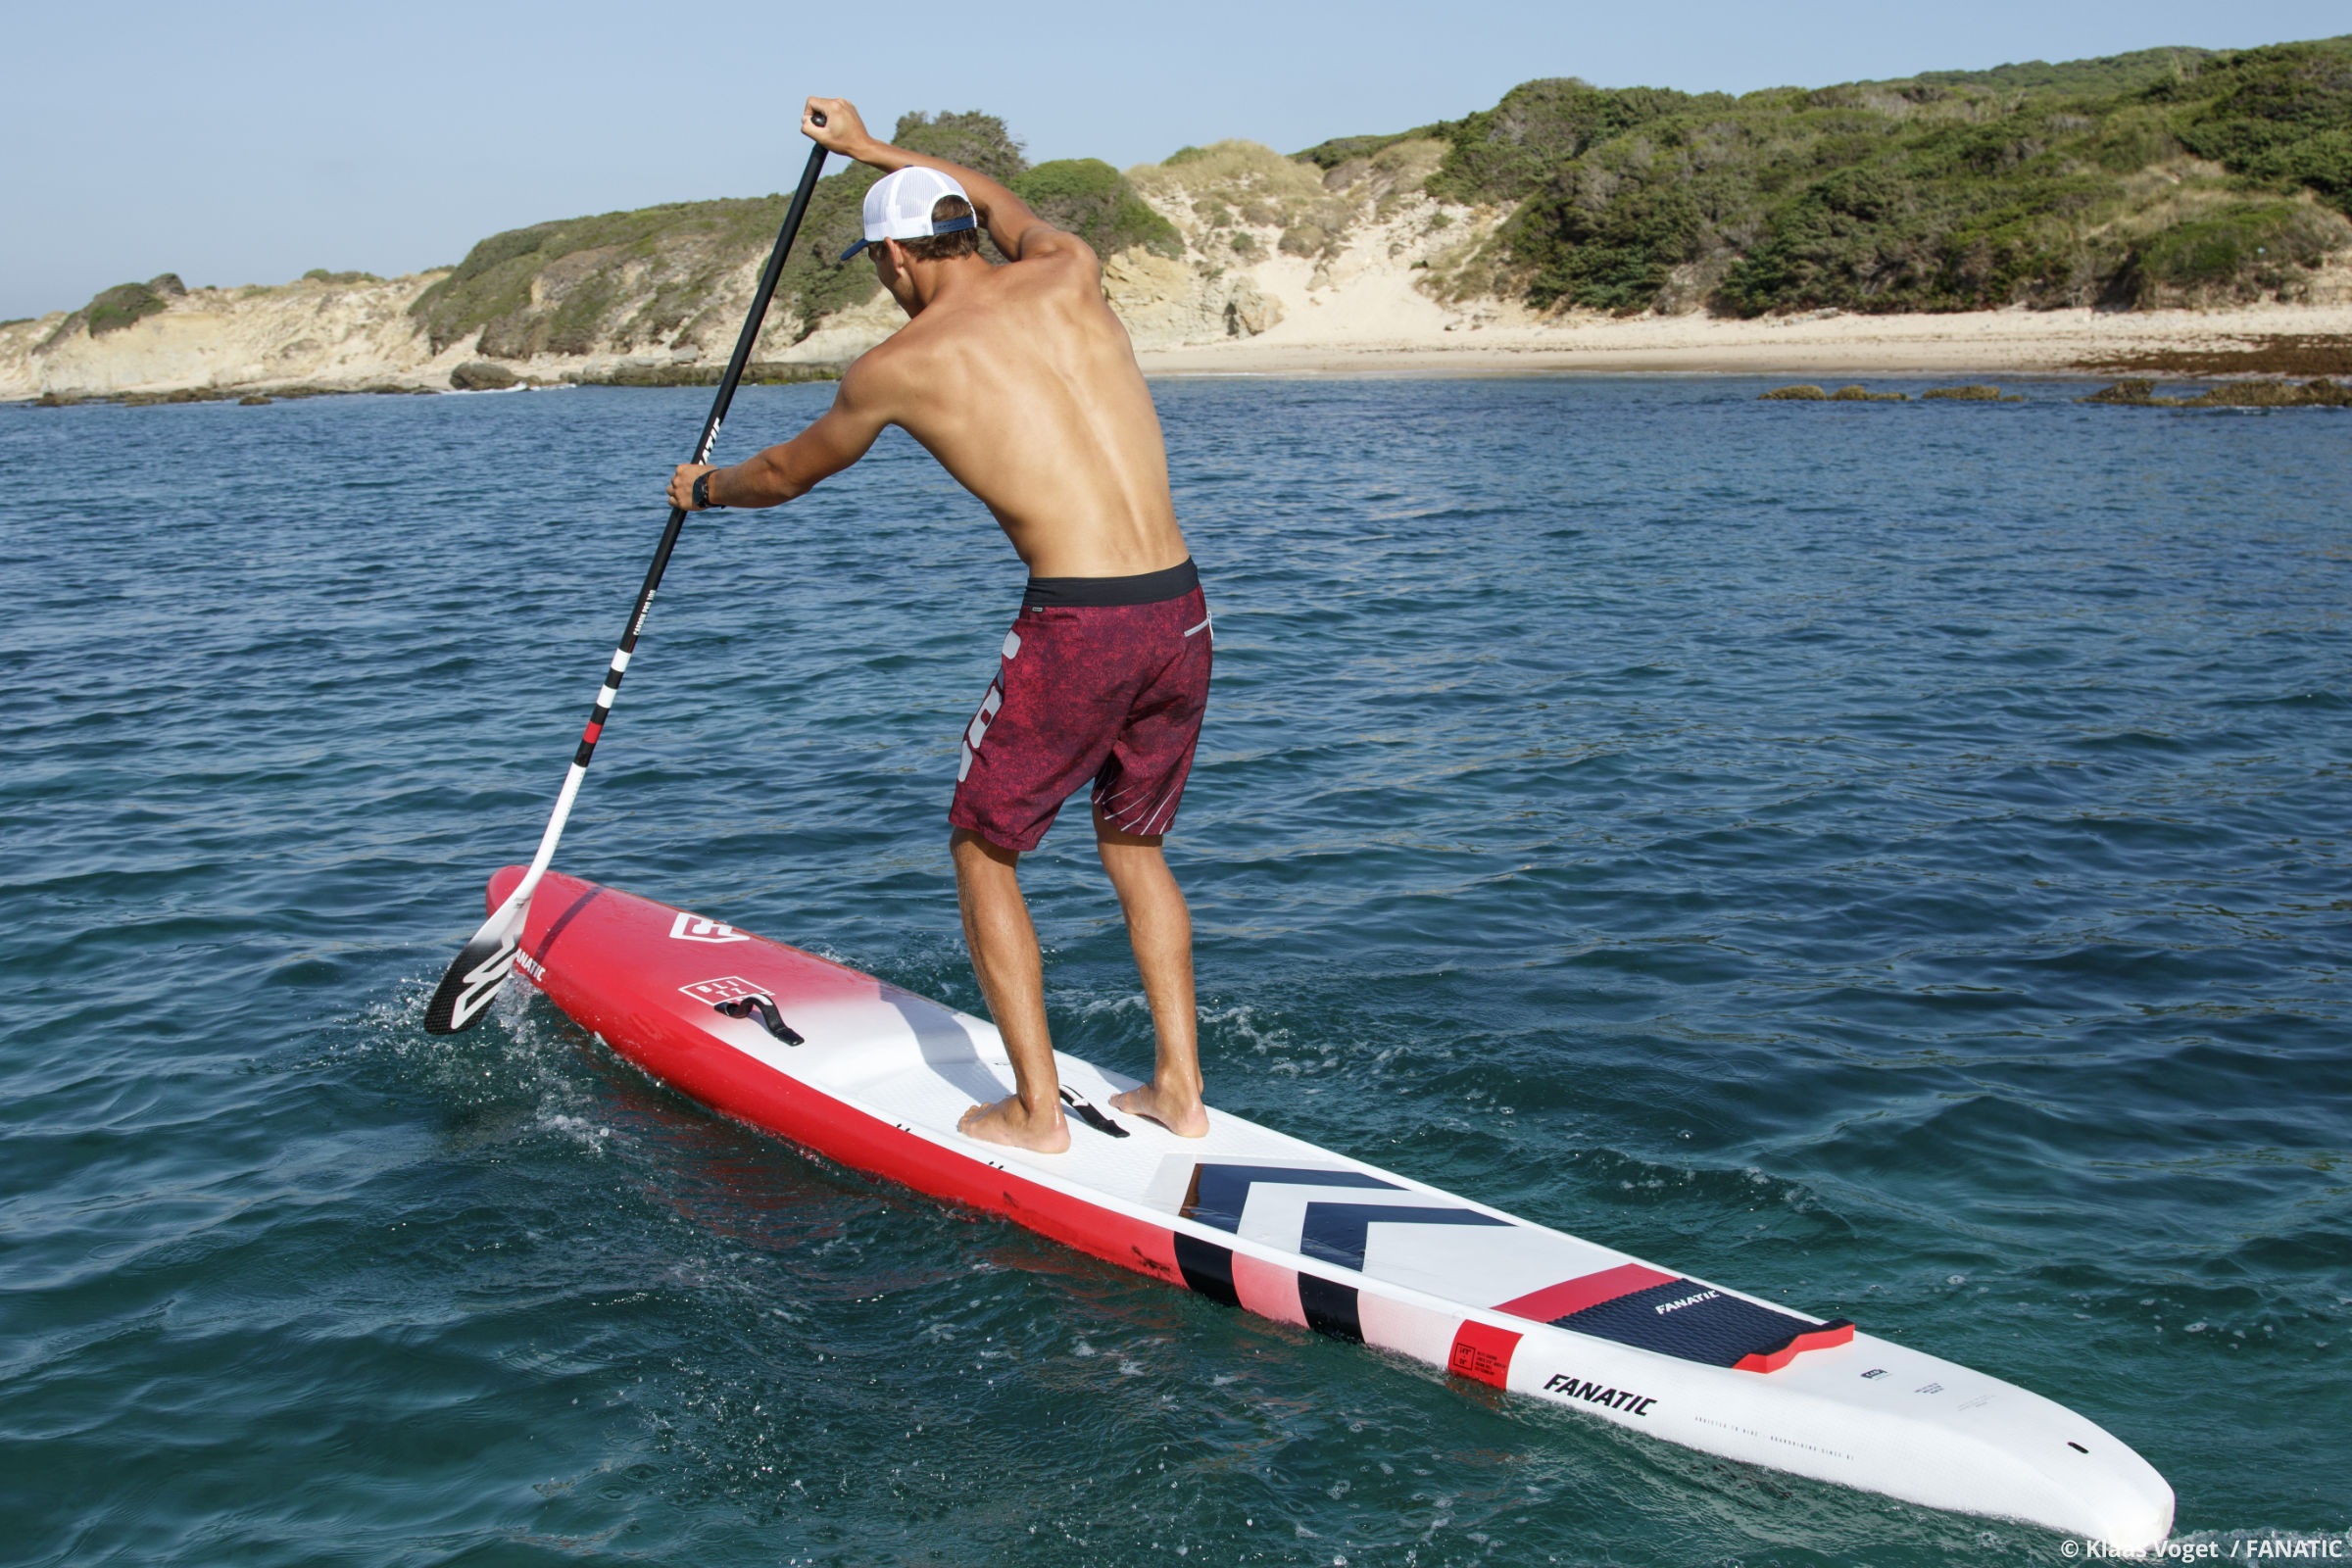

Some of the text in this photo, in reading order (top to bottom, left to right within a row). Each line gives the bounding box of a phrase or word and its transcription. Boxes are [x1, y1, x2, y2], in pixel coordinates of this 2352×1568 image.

[515, 947, 547, 982] ANATIC
[1654, 1290, 1721, 1316] FANATIC
[1543, 1373, 1658, 1417] FANATIC
